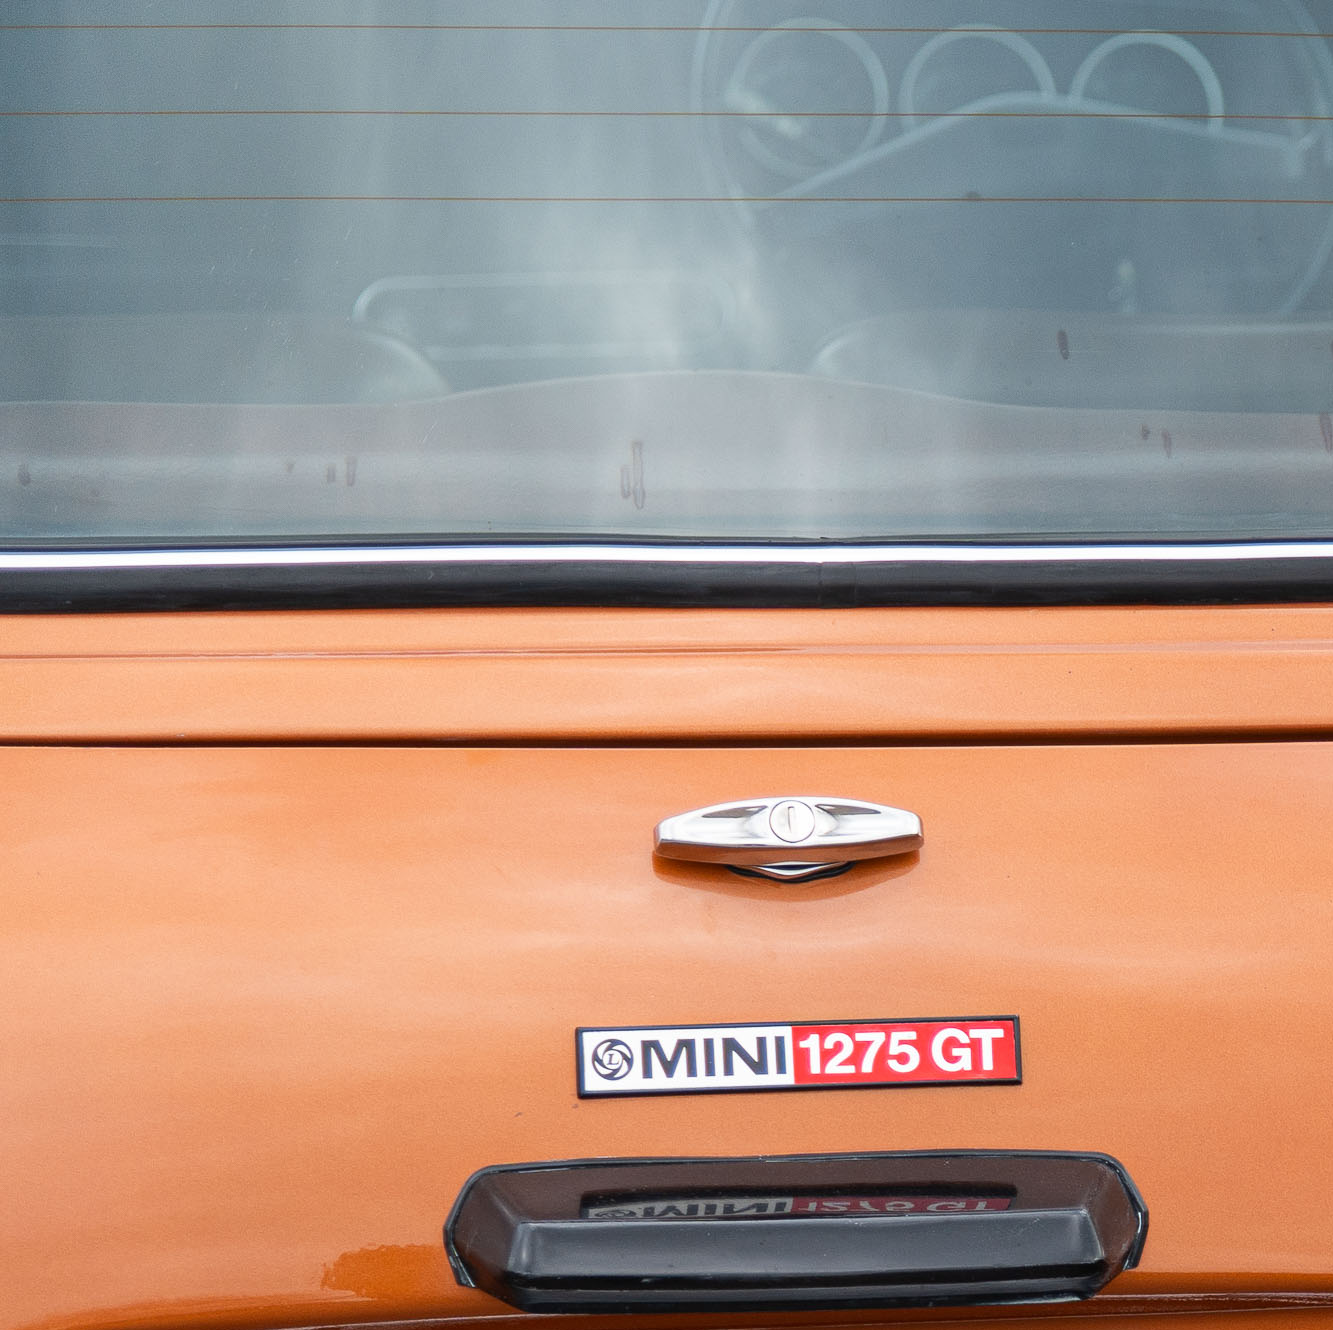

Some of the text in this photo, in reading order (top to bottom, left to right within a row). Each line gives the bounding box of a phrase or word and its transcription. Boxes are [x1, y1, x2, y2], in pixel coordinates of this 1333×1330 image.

[607, 1028, 1004, 1079] L MINI 1275 GT
